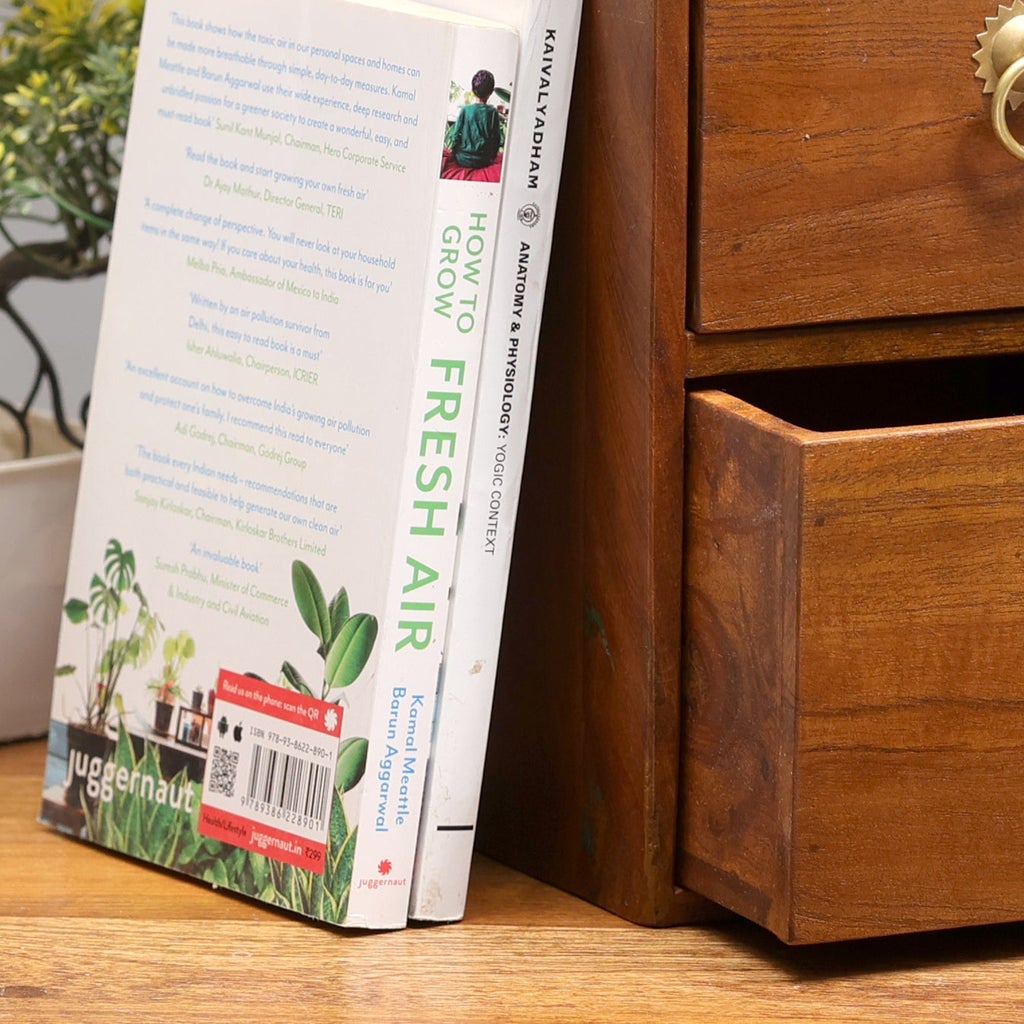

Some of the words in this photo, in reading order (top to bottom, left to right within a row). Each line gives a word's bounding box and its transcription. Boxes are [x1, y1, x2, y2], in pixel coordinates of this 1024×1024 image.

[276, 37, 287, 47] air
[287, 38, 295, 49] in
[296, 43, 309, 52] our
[310, 46, 341, 59] personal
[341, 53, 365, 65] spaces
[366, 57, 381, 68] and
[381, 58, 405, 74] homes
[406, 67, 420, 77] can
[223, 72, 261, 90] Aggarwal
[261, 84, 274, 93] use
[276, 83, 292, 97] their
[294, 90, 311, 101] wide
[353, 101, 370, 117] deep
[371, 108, 401, 122] research
[403, 114, 418, 126] and
[315, 68, 353, 90] day-to-day
[391, 84, 415, 101] Kamal
[528, 28, 556, 189] KAIVALYADHAM
[298, 114, 306, 125] to
[306, 118, 328, 130] create
[393, 137, 408, 148] and
[323, 142, 340, 157] Hero
[342, 146, 378, 166] Corporate
[380, 155, 405, 172] Service
[219, 155, 238, 170] book
[239, 162, 255, 173] and
[255, 166, 272, 177] start
[273, 171, 304, 188] growing
[304, 179, 320, 189] your
[321, 182, 336, 192] own
[337, 182, 354, 197] fresh
[263, 188, 293, 206] Director
[267, 226, 281, 240] You
[282, 232, 295, 243] will
[295, 237, 314, 248] never
[315, 239, 330, 253] look
[331, 246, 339, 255] at
[340, 249, 356, 259] your
[357, 249, 395, 269] household
[462, 213, 488, 286] HOW
[282, 259, 298, 268] your
[325, 266, 337, 279] this
[338, 268, 355, 284] book
[357, 274, 363, 286] is
[364, 275, 374, 288] for
[434, 225, 462, 319] GROW
[512, 241, 530, 318] ANATOMY
[285, 279, 311, 297] Mexico
[312, 289, 319, 299] to
[321, 288, 338, 304] India
[251, 310, 283, 326] pollution
[284, 320, 312, 333] survivor
[313, 323, 329, 339] from
[456, 294, 478, 334] TO
[510, 322, 521, 332] &
[252, 336, 269, 347] read
[270, 337, 288, 352] book
[289, 343, 294, 354] is
[498, 338, 519, 438] PHYSIOLOGY:
[230, 416, 273, 434] recommend
[274, 424, 286, 438] this
[288, 432, 304, 443] read
[305, 435, 313, 446] to
[296, 409, 325, 428] growing
[326, 416, 336, 427] air
[337, 419, 370, 436] pollution
[258, 443, 282, 464] Godrej
[284, 451, 306, 470] Group
[409, 358, 466, 536] FRESH
[492, 444, 508, 486] YOGIC
[244, 479, 307, 504] recommendations
[309, 494, 323, 508] that
[324, 500, 337, 513] are
[245, 502, 277, 518] generate
[278, 511, 291, 521] our
[291, 515, 307, 526] own
[308, 517, 327, 532] clean
[484, 490, 502, 555] CONTEXT
[299, 537, 326, 556] Limited
[249, 584, 288, 607] Commerce
[395, 556, 439, 652] AIR
[239, 607, 269, 625] Aviation
[222, 679, 238, 694] Read
[252, 690, 262, 702] the
[283, 703, 296, 712] scan
[297, 703, 307, 716] the
[308, 707, 320, 721] QR
[387, 687, 406, 739] Barun
[249, 726, 265, 738] ISBN
[406, 694, 424, 752] Kamal
[63, 748, 195, 813] juggernaut
[376, 744, 398, 832] Aggarwal
[395, 757, 416, 825] Meattle
[249, 826, 302, 855] juggernaut.in
[358, 878, 406, 890] juggernaut
